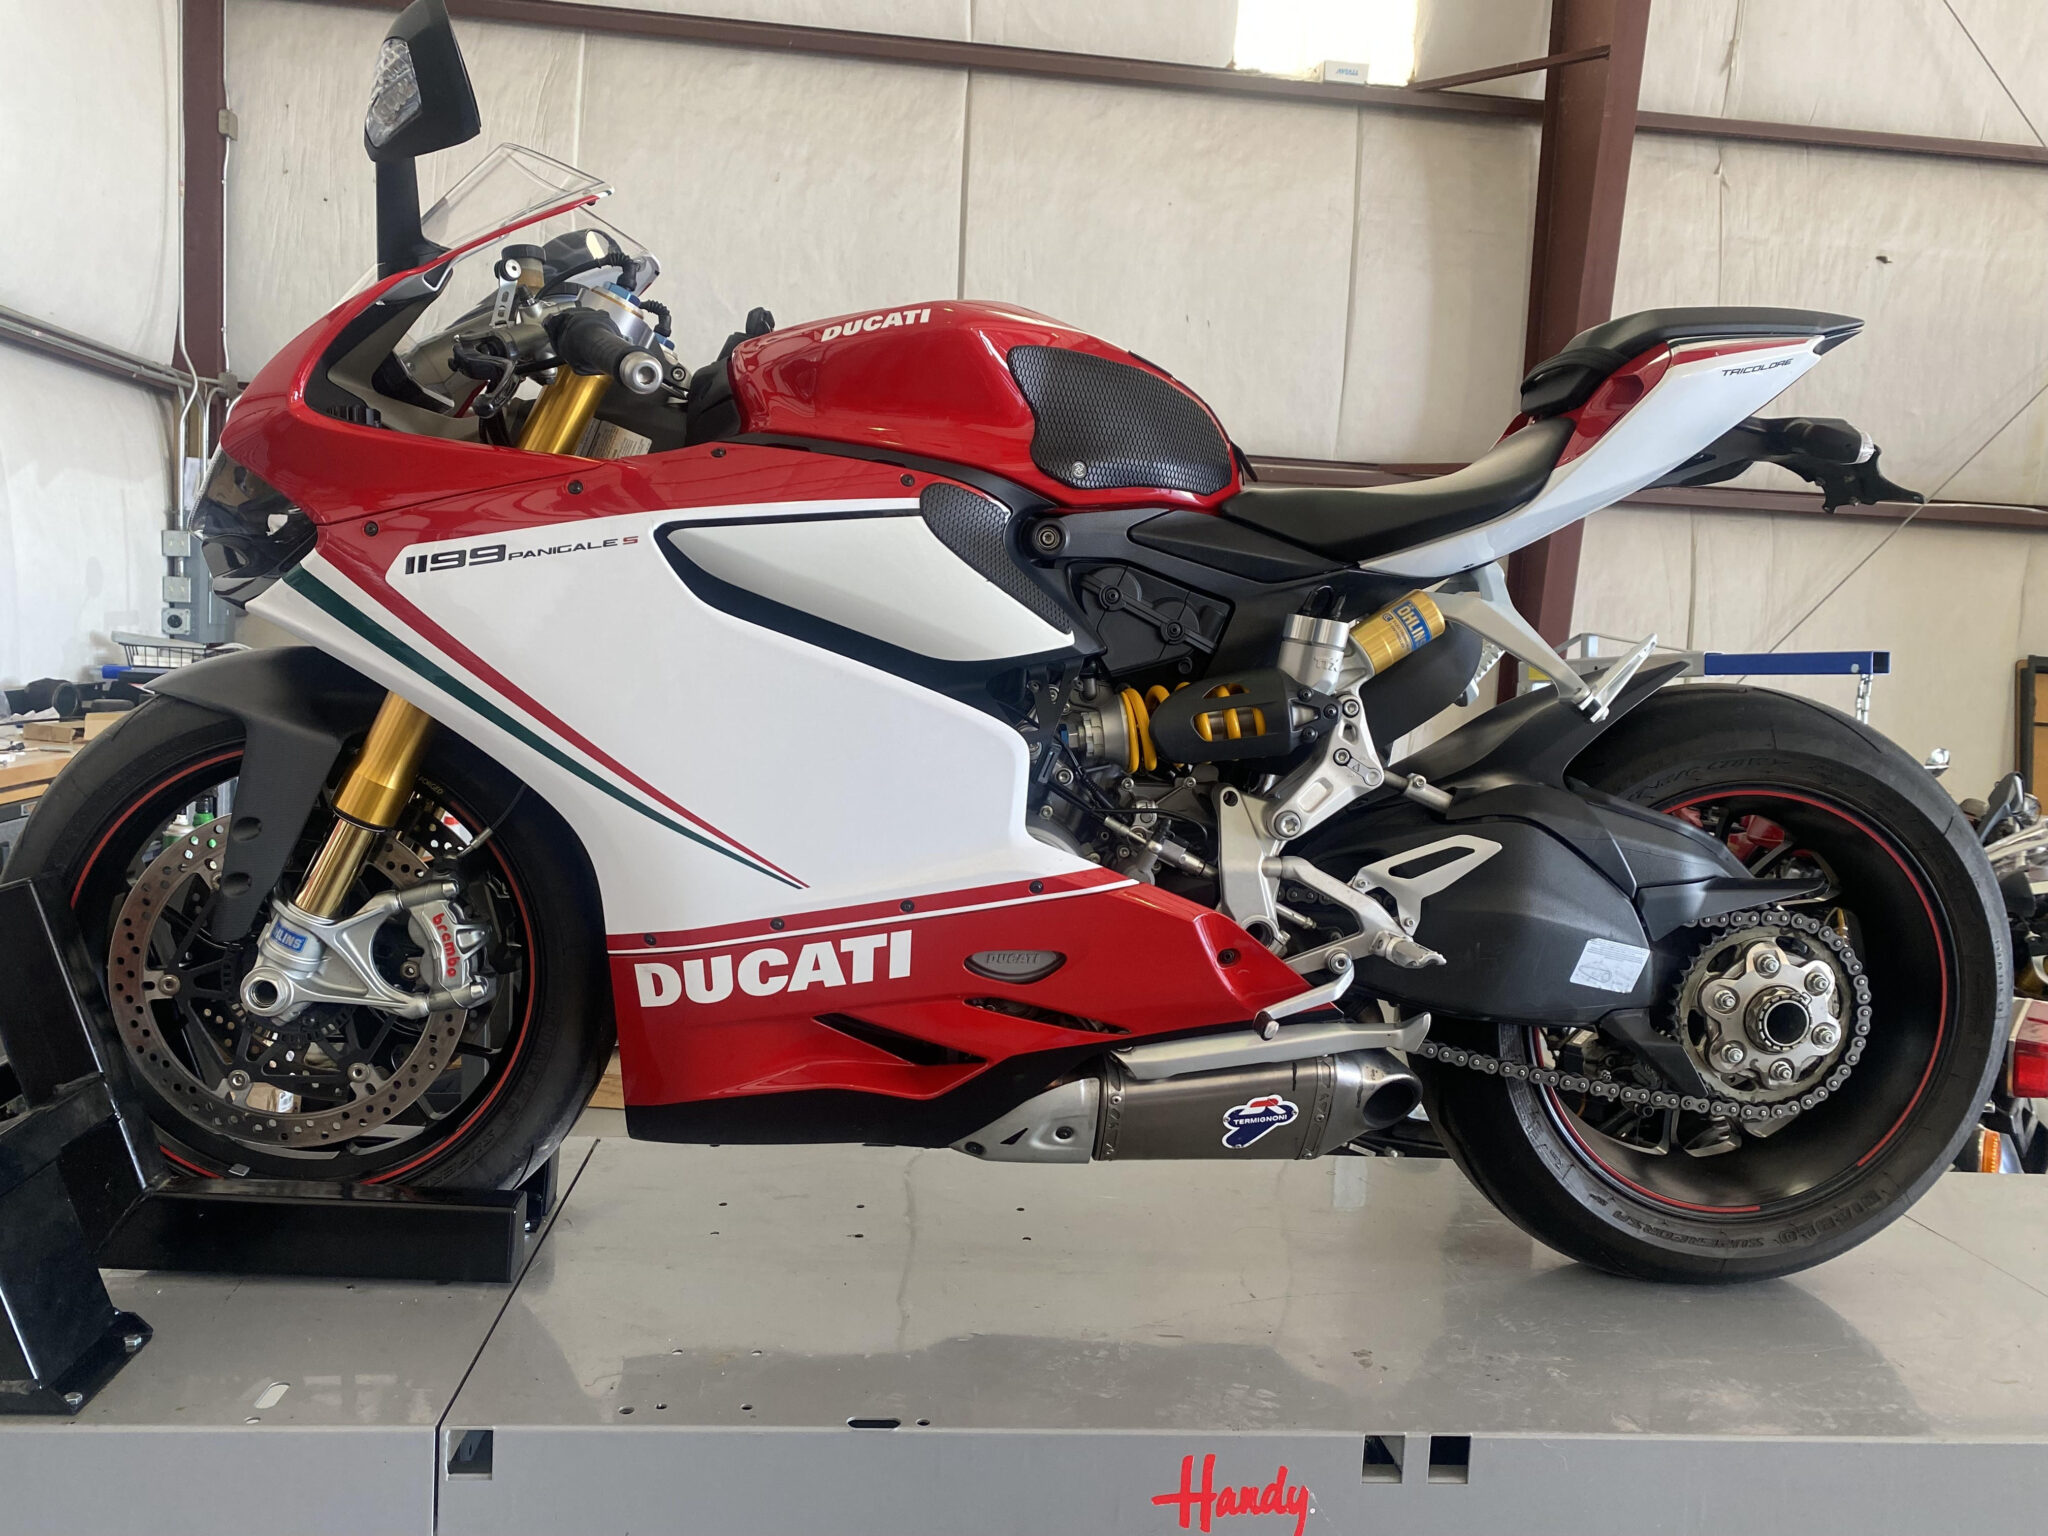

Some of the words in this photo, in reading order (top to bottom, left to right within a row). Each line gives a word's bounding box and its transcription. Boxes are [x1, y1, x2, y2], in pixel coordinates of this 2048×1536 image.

[821, 308, 931, 342] DUCATI
[1721, 358, 1794, 376] TRICOLORE
[405, 544, 507, 575] 1199
[508, 538, 619, 561] PANIGALE
[622, 536, 639, 545] S
[432, 912, 461, 978] brembo
[986, 952, 1040, 964] DUCATI
[633, 929, 913, 1008] DUCATI
[1233, 1114, 1288, 1125] TERMIGNONI
[1151, 1453, 1309, 1536] Handy
